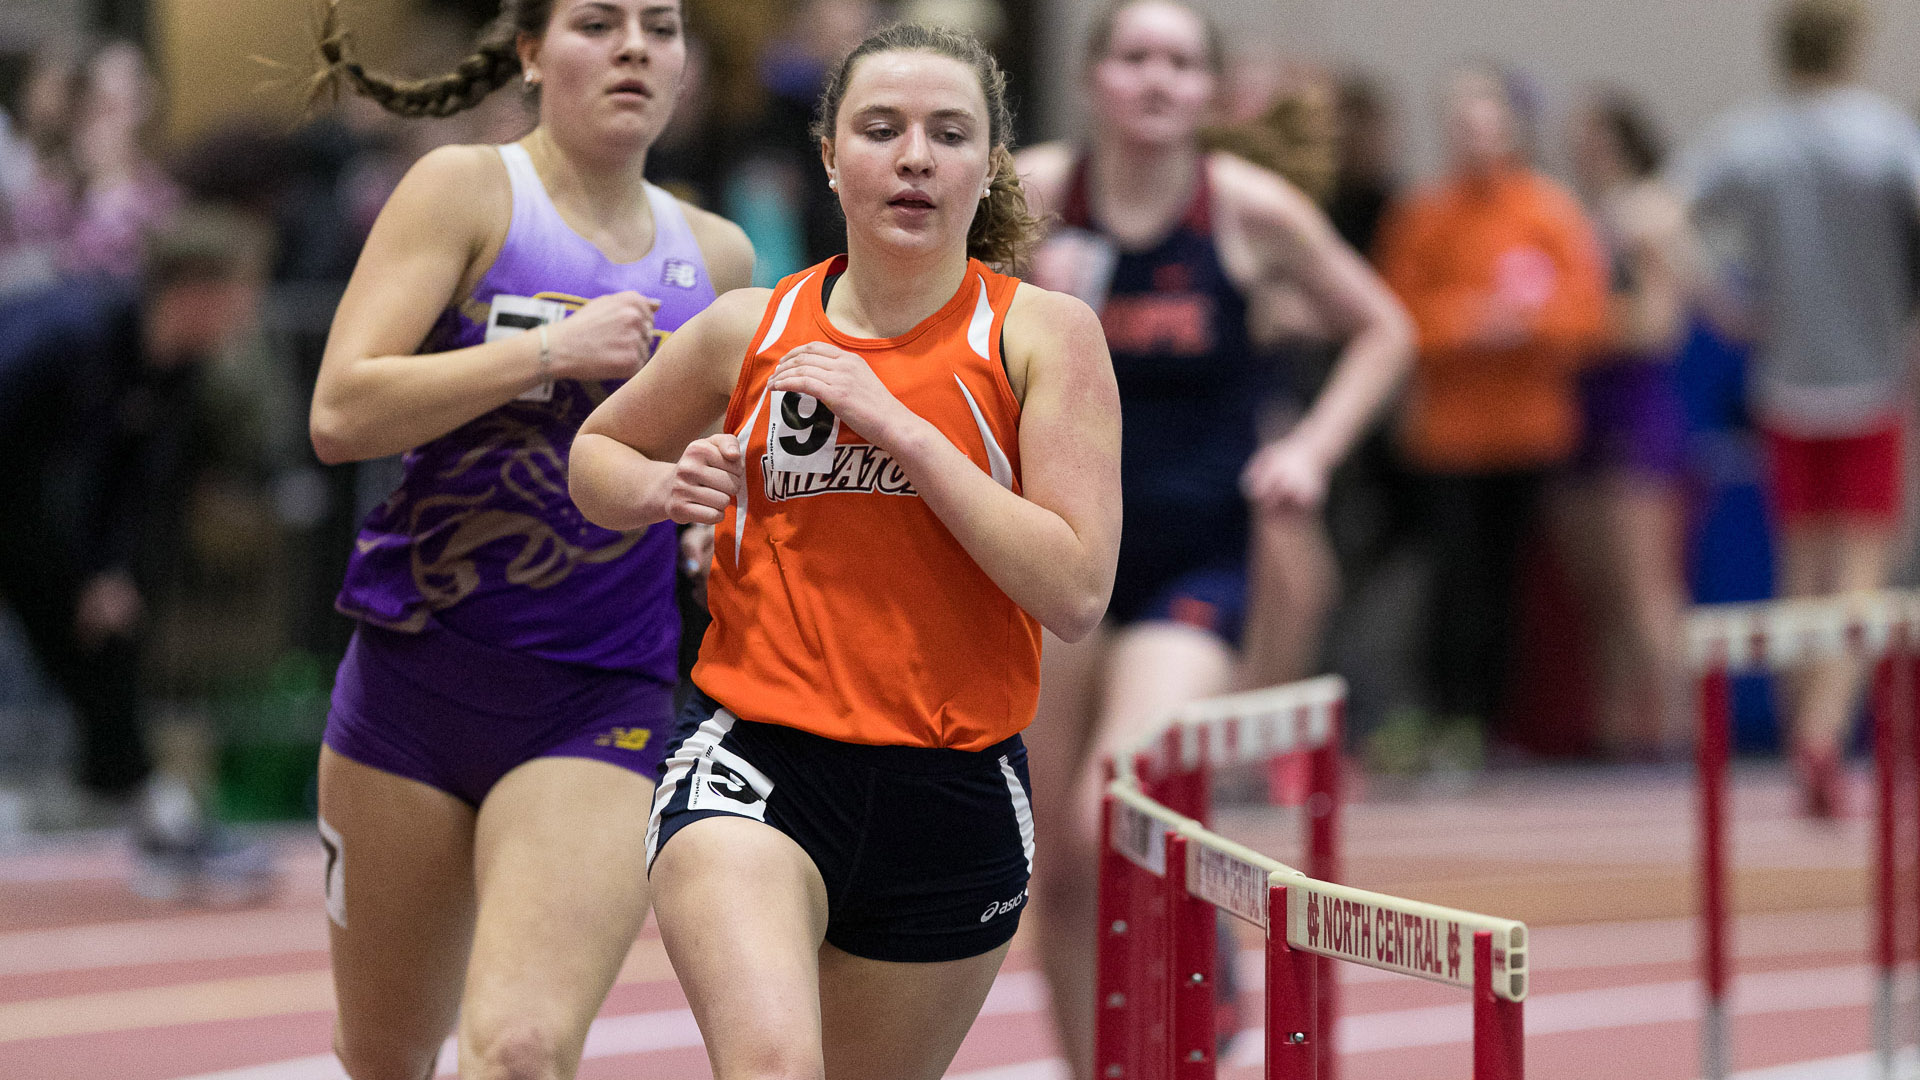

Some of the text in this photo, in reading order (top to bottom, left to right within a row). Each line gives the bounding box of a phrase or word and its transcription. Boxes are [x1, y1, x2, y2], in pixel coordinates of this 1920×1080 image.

[779, 390, 835, 456] 9
[761, 444, 919, 502] WHEATO
[998, 890, 1024, 915] asics
[1323, 895, 1371, 959] NORTH
[1375, 907, 1442, 975] CENTRAL
